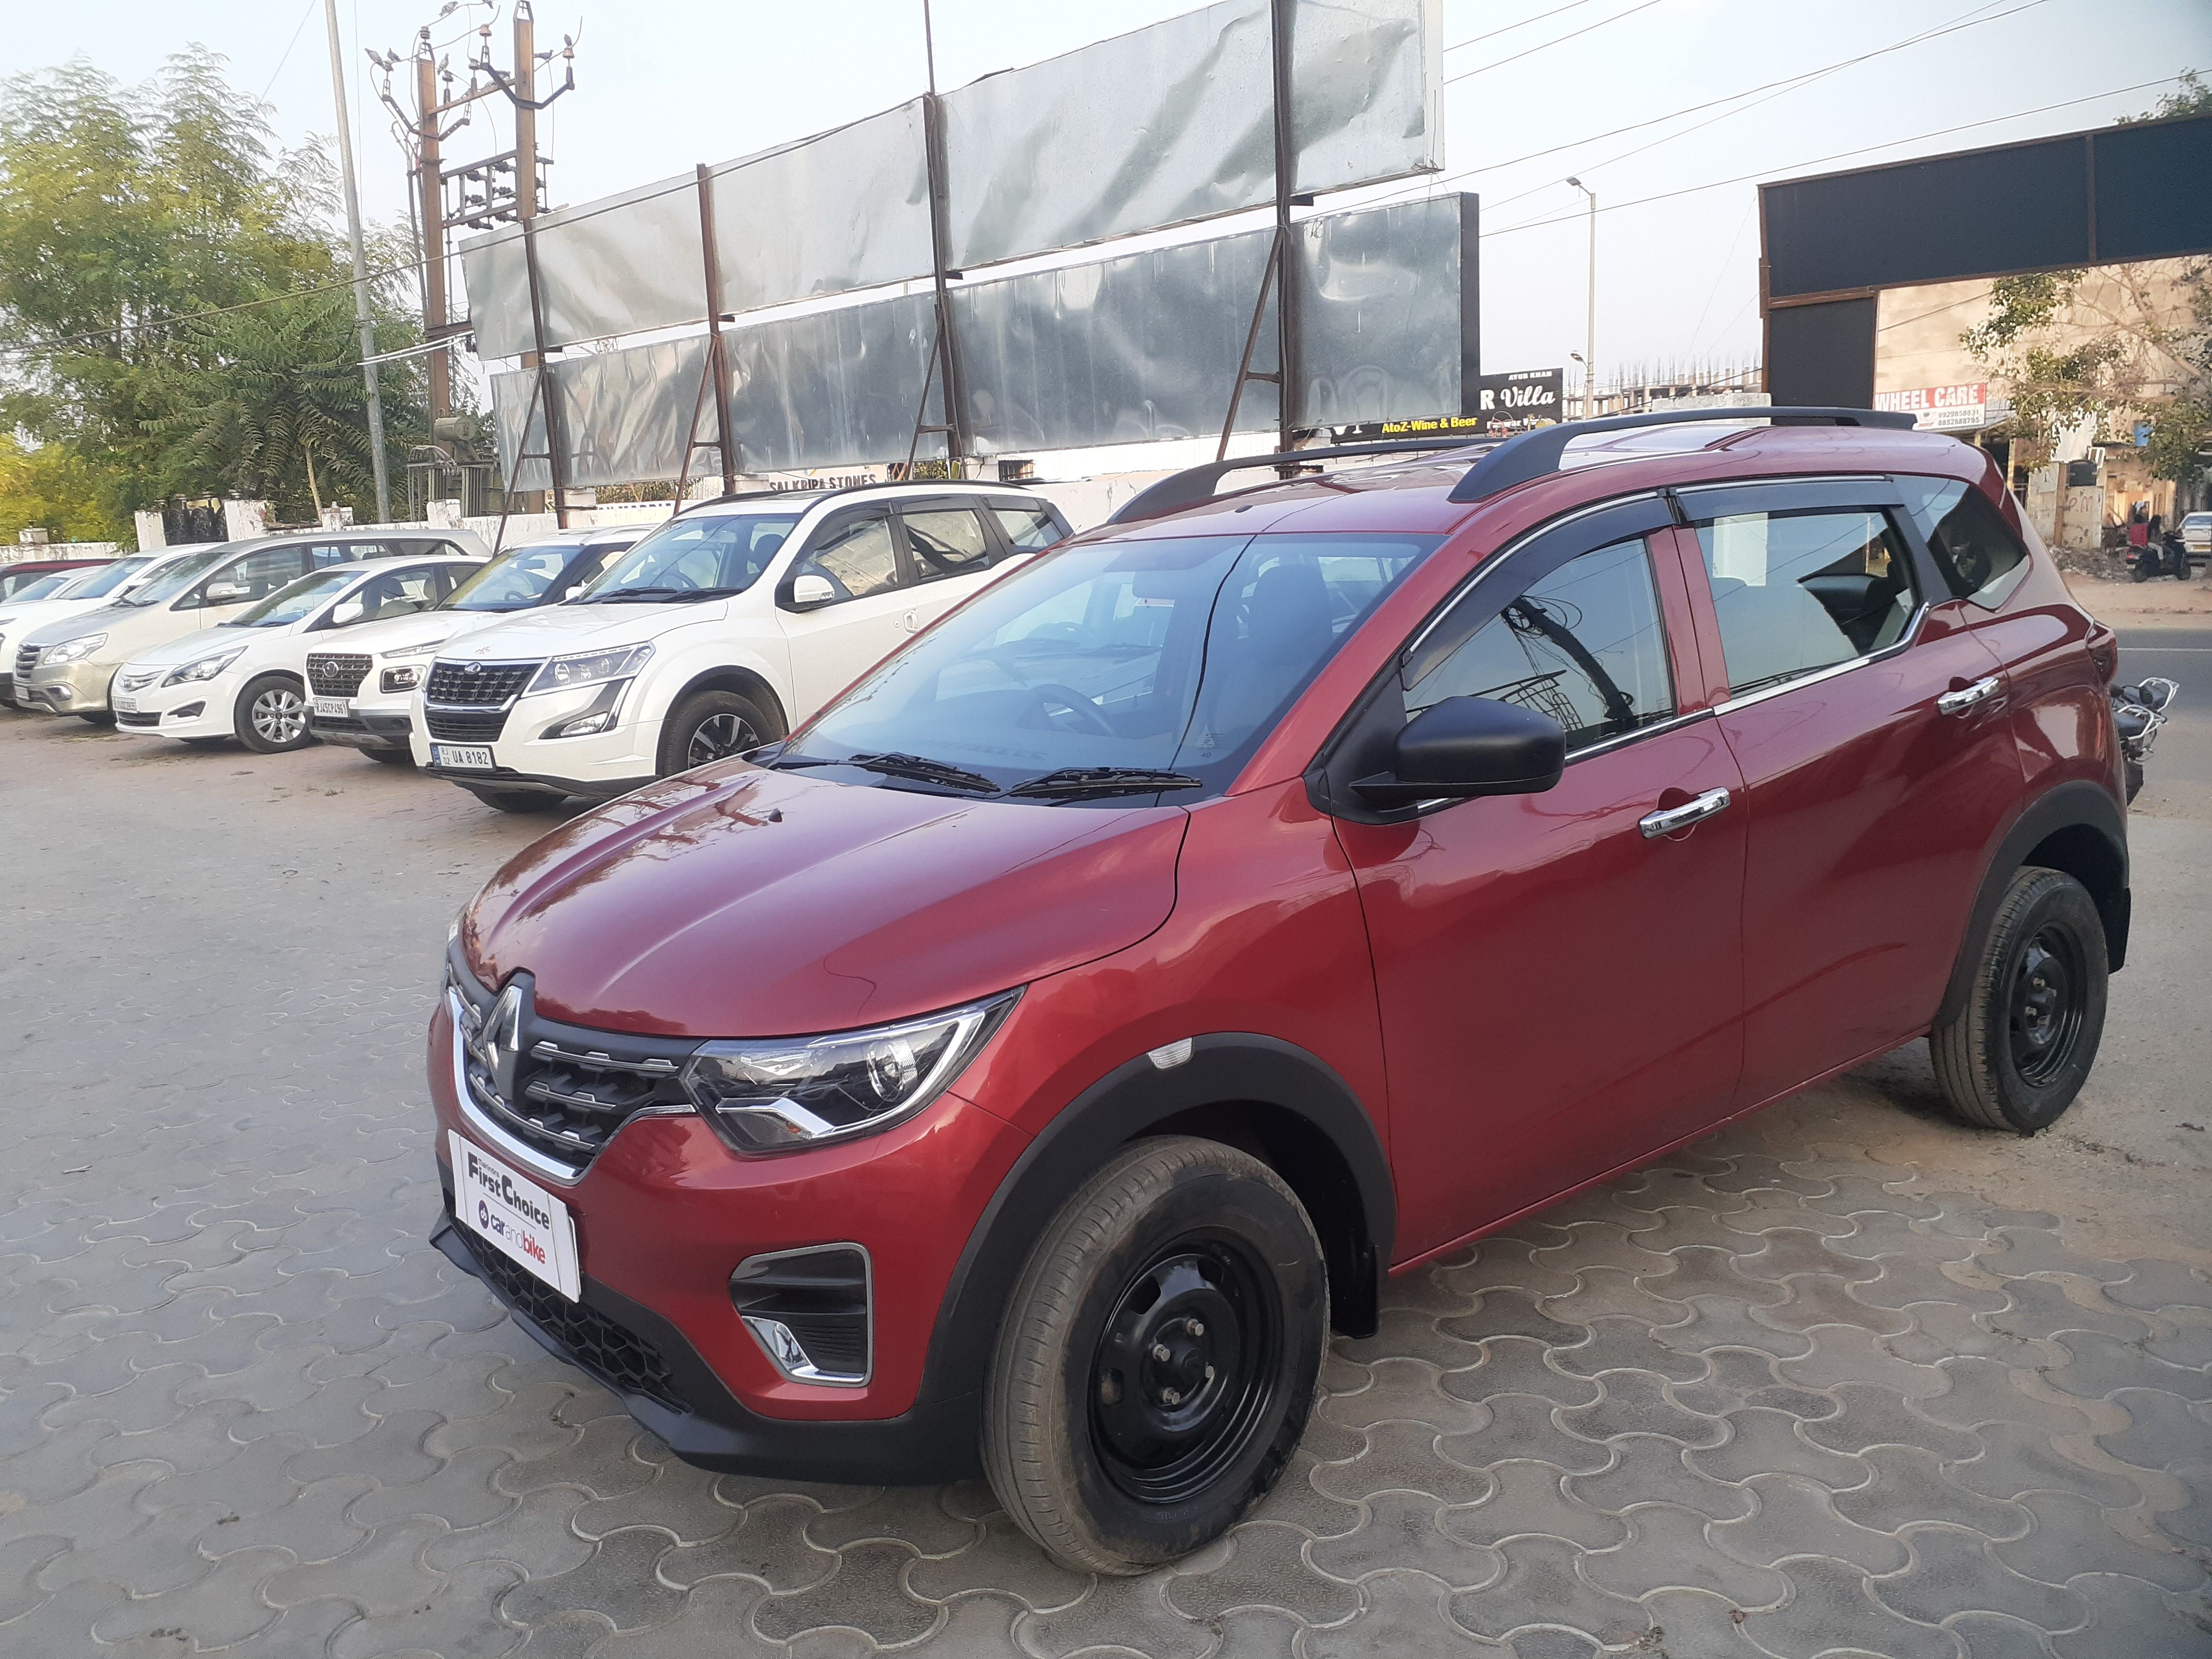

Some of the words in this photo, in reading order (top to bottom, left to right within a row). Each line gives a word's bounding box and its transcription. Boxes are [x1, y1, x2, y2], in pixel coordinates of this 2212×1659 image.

[1500, 385, 1556, 408] Villa
[1875, 390, 1929, 411] WHEEL
[1934, 384, 1978, 407] CARE
[1382, 420, 1438, 434] AtoZ-Wine
[1440, 418, 1448, 429] &
[1451, 417, 1478, 428] Beer
[829, 474, 876, 489] STONES
[452, 750, 464, 764] UA
[466, 751, 489, 764] 8182
